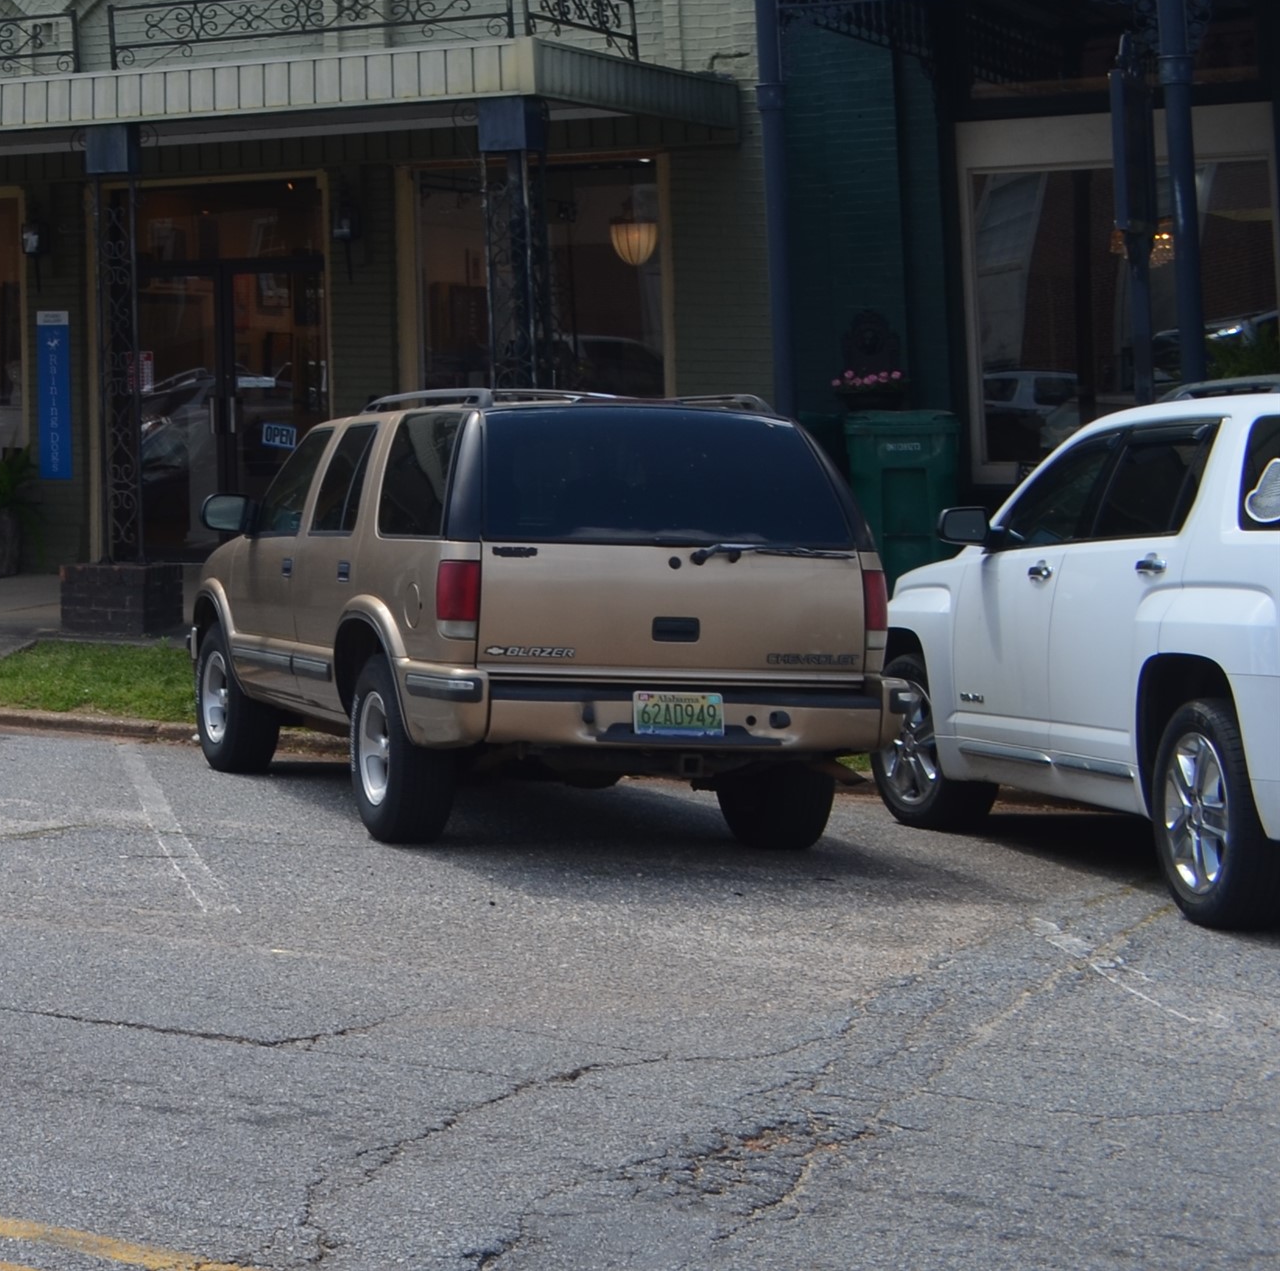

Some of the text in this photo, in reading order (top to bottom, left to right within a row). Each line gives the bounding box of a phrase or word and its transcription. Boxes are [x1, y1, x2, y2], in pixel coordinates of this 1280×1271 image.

[48, 353, 60, 473] Raining Dogs
[265, 425, 295, 447] OPEN
[506, 647, 575, 657] BLAZER
[767, 653, 859, 665] CHEVROLET
[657, 694, 699, 703] Alabama
[641, 703, 716, 726] 62AD949
